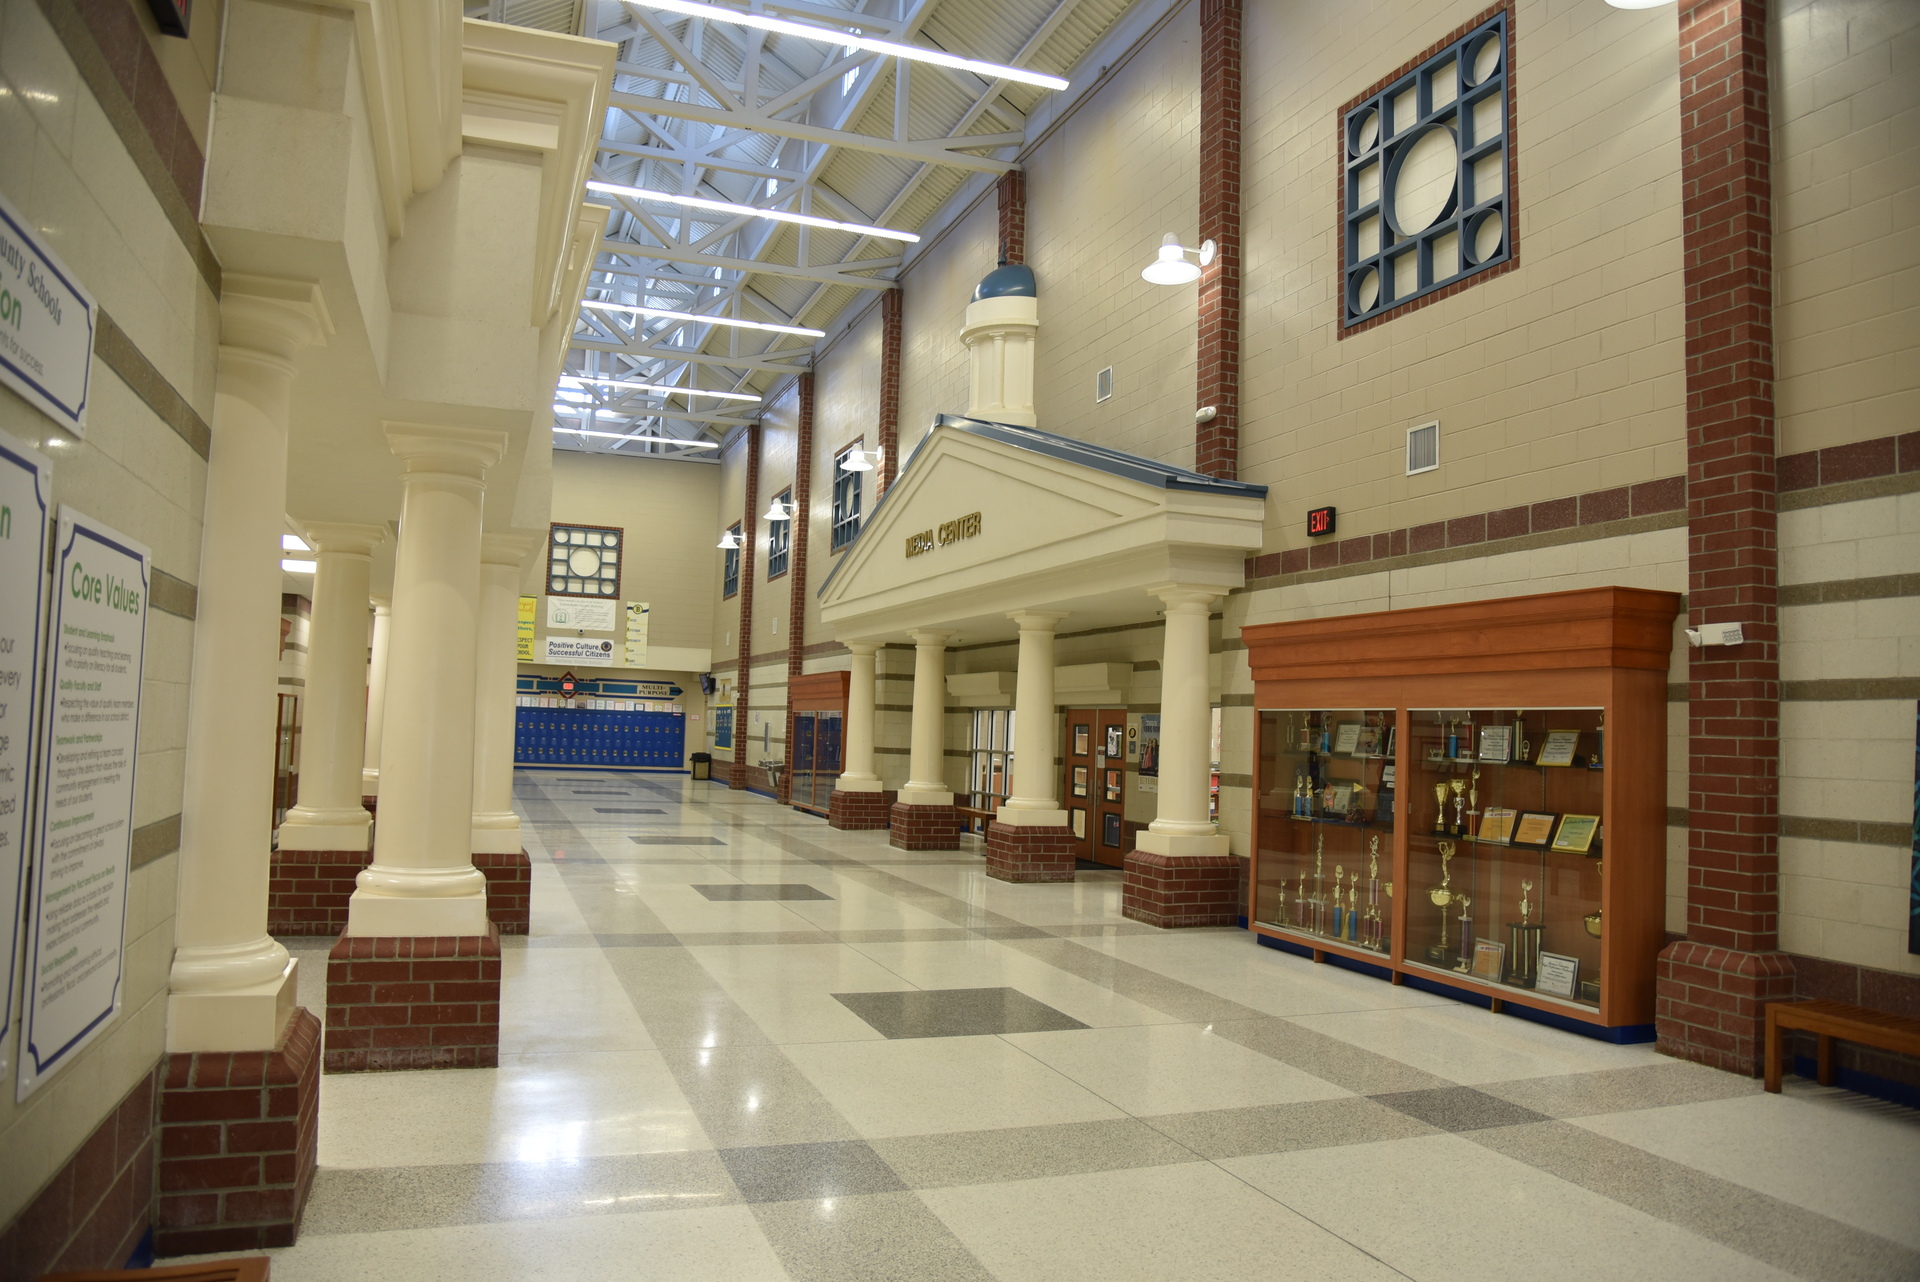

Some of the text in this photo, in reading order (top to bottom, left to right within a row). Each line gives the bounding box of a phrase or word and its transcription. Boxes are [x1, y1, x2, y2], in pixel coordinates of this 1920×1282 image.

[0, 235, 62, 325] unty Schools
[905, 511, 982, 559] MEDIA CENTER
[1311, 510, 1328, 532] EXIT
[71, 561, 140, 615] Core Values
[548, 641, 601, 651] Positive Culture,
[548, 648, 611, 658] Successful Citizens
